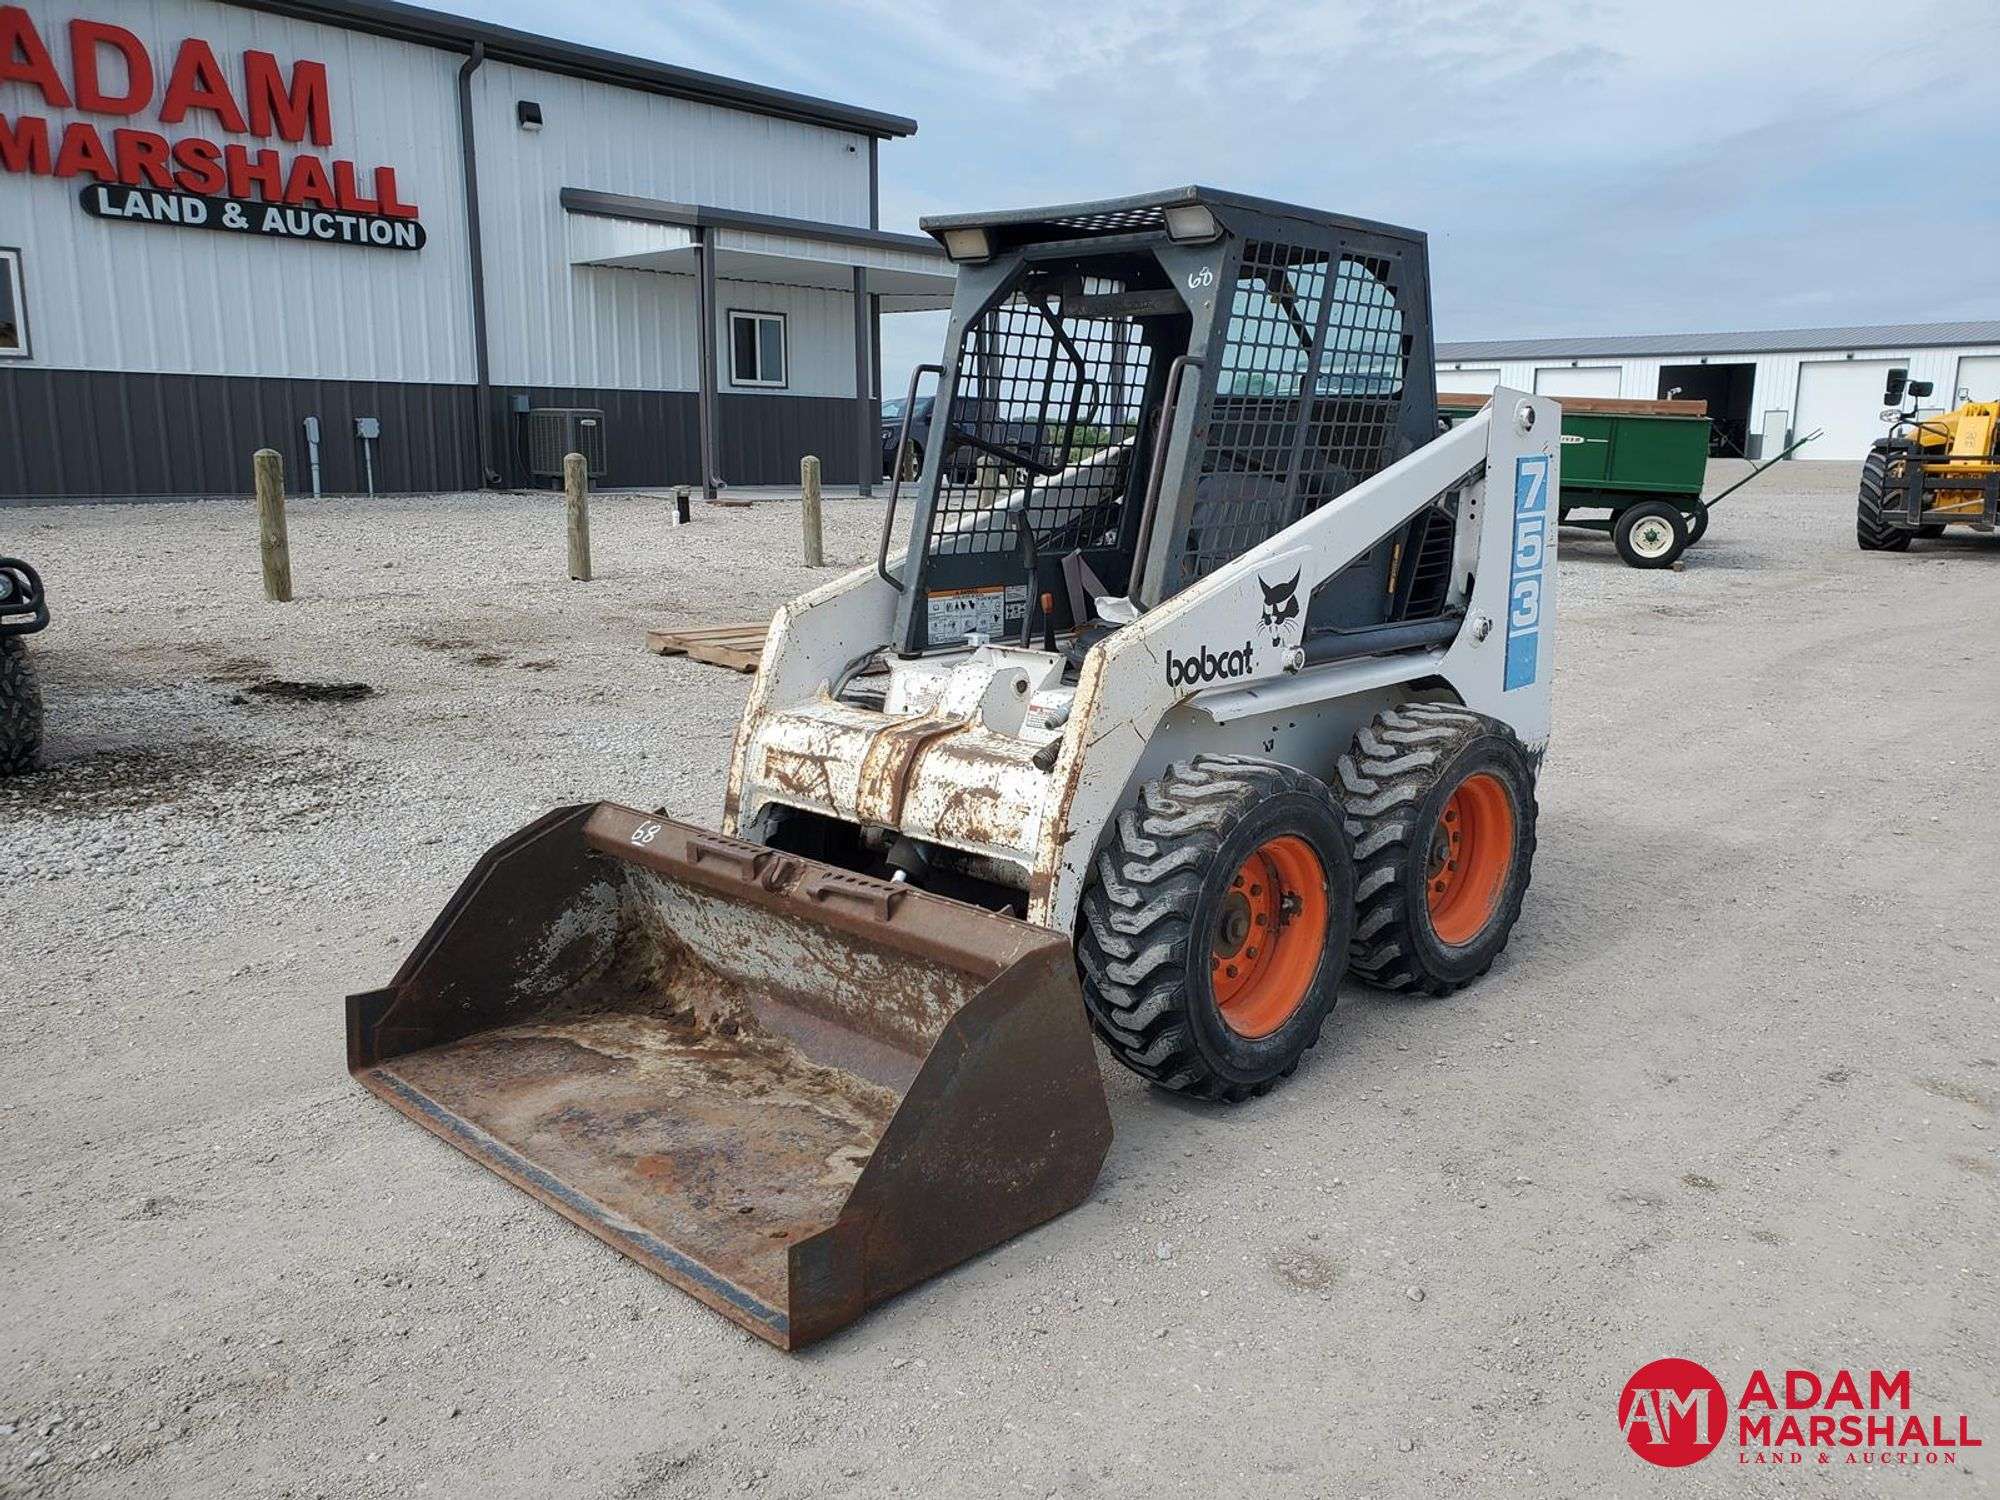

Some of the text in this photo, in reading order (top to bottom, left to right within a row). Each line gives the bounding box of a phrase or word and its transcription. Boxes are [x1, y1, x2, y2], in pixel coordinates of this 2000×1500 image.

[0, 5, 332, 146] ADAM
[0, 113, 419, 219] MARSHALL
[98, 187, 417, 248] LAND & AUCTION
[1512, 461, 1546, 627] 753
[1166, 641, 1253, 687] bobcat
[631, 820, 662, 846] 68
